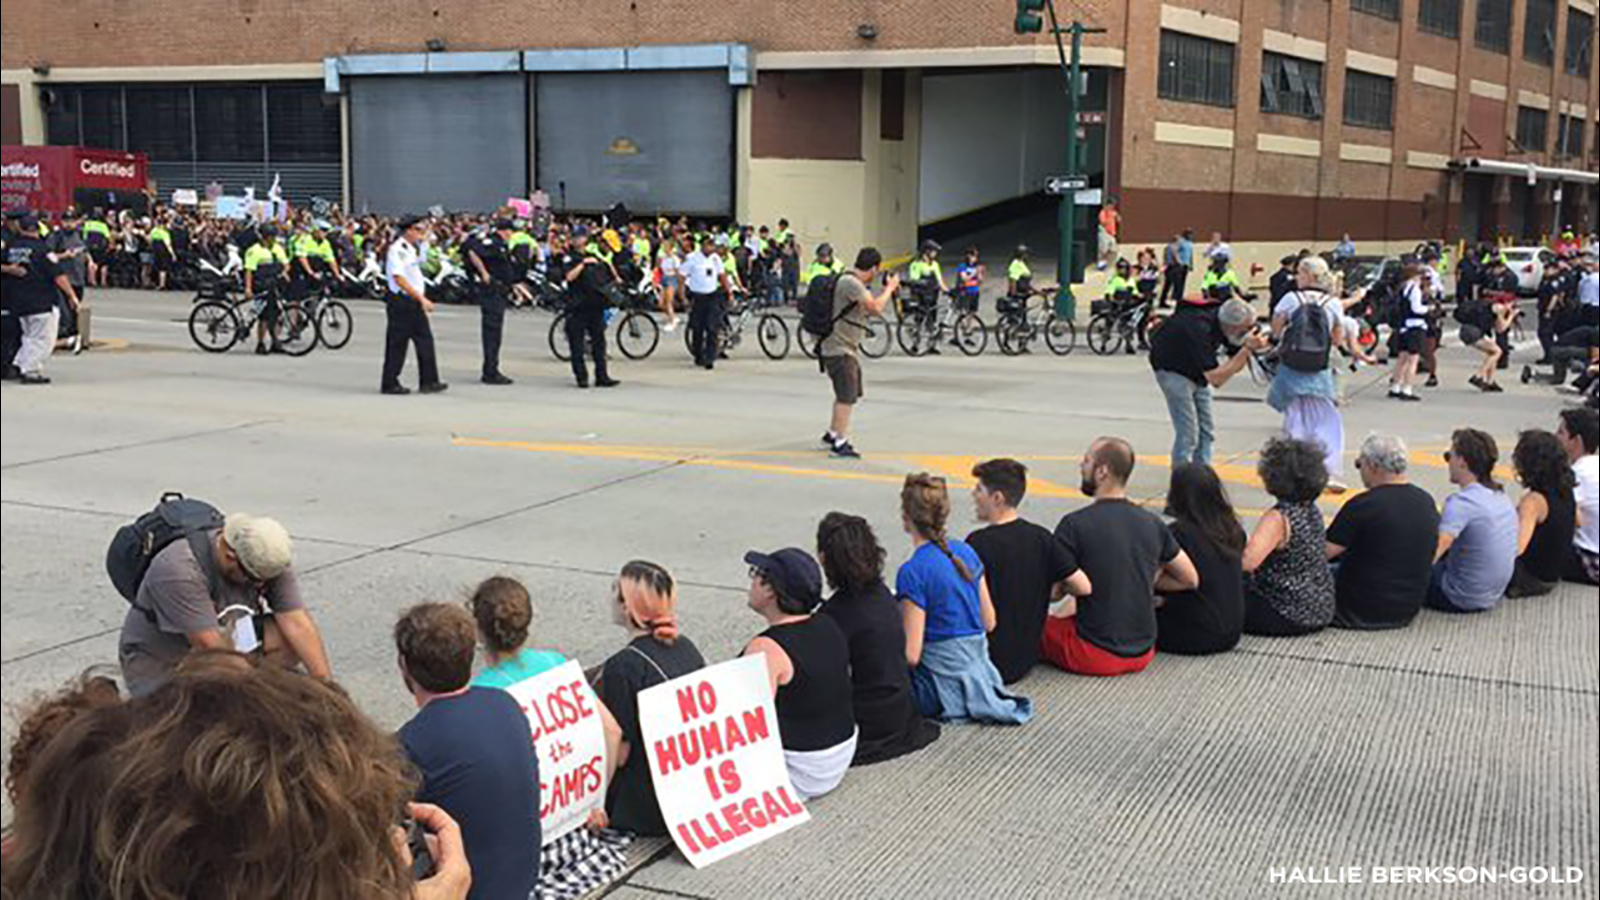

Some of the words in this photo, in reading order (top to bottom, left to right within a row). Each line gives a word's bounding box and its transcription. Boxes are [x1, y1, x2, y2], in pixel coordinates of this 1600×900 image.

[80, 159, 135, 178] Certified
[677, 680, 717, 724] NO
[549, 738, 574, 763] the
[654, 705, 769, 776] HUMAN
[704, 760, 742, 801] IS
[677, 785, 803, 855] ILLEGAL
